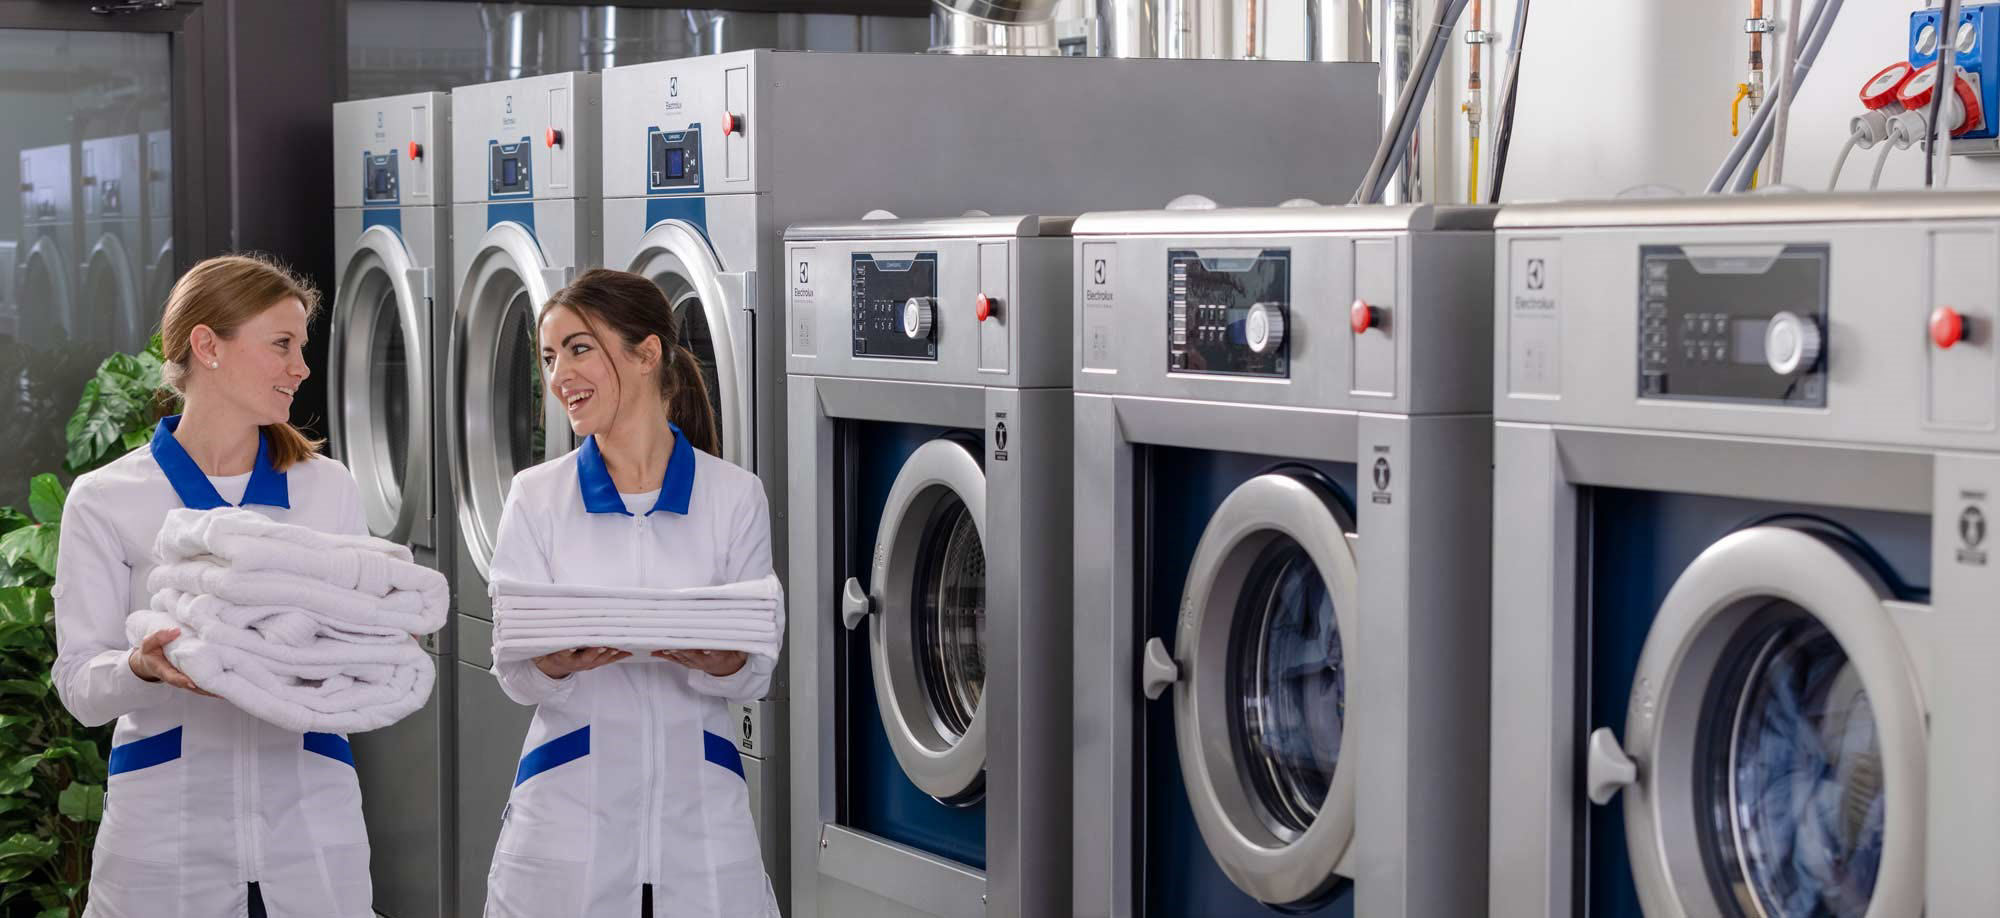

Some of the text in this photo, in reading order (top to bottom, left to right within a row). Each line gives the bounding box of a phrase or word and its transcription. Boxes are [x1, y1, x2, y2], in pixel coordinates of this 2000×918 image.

[794, 287, 814, 297] Electrolux
[1087, 289, 1113, 301] Electrolux
[1515, 295, 1555, 310] Electrolux
